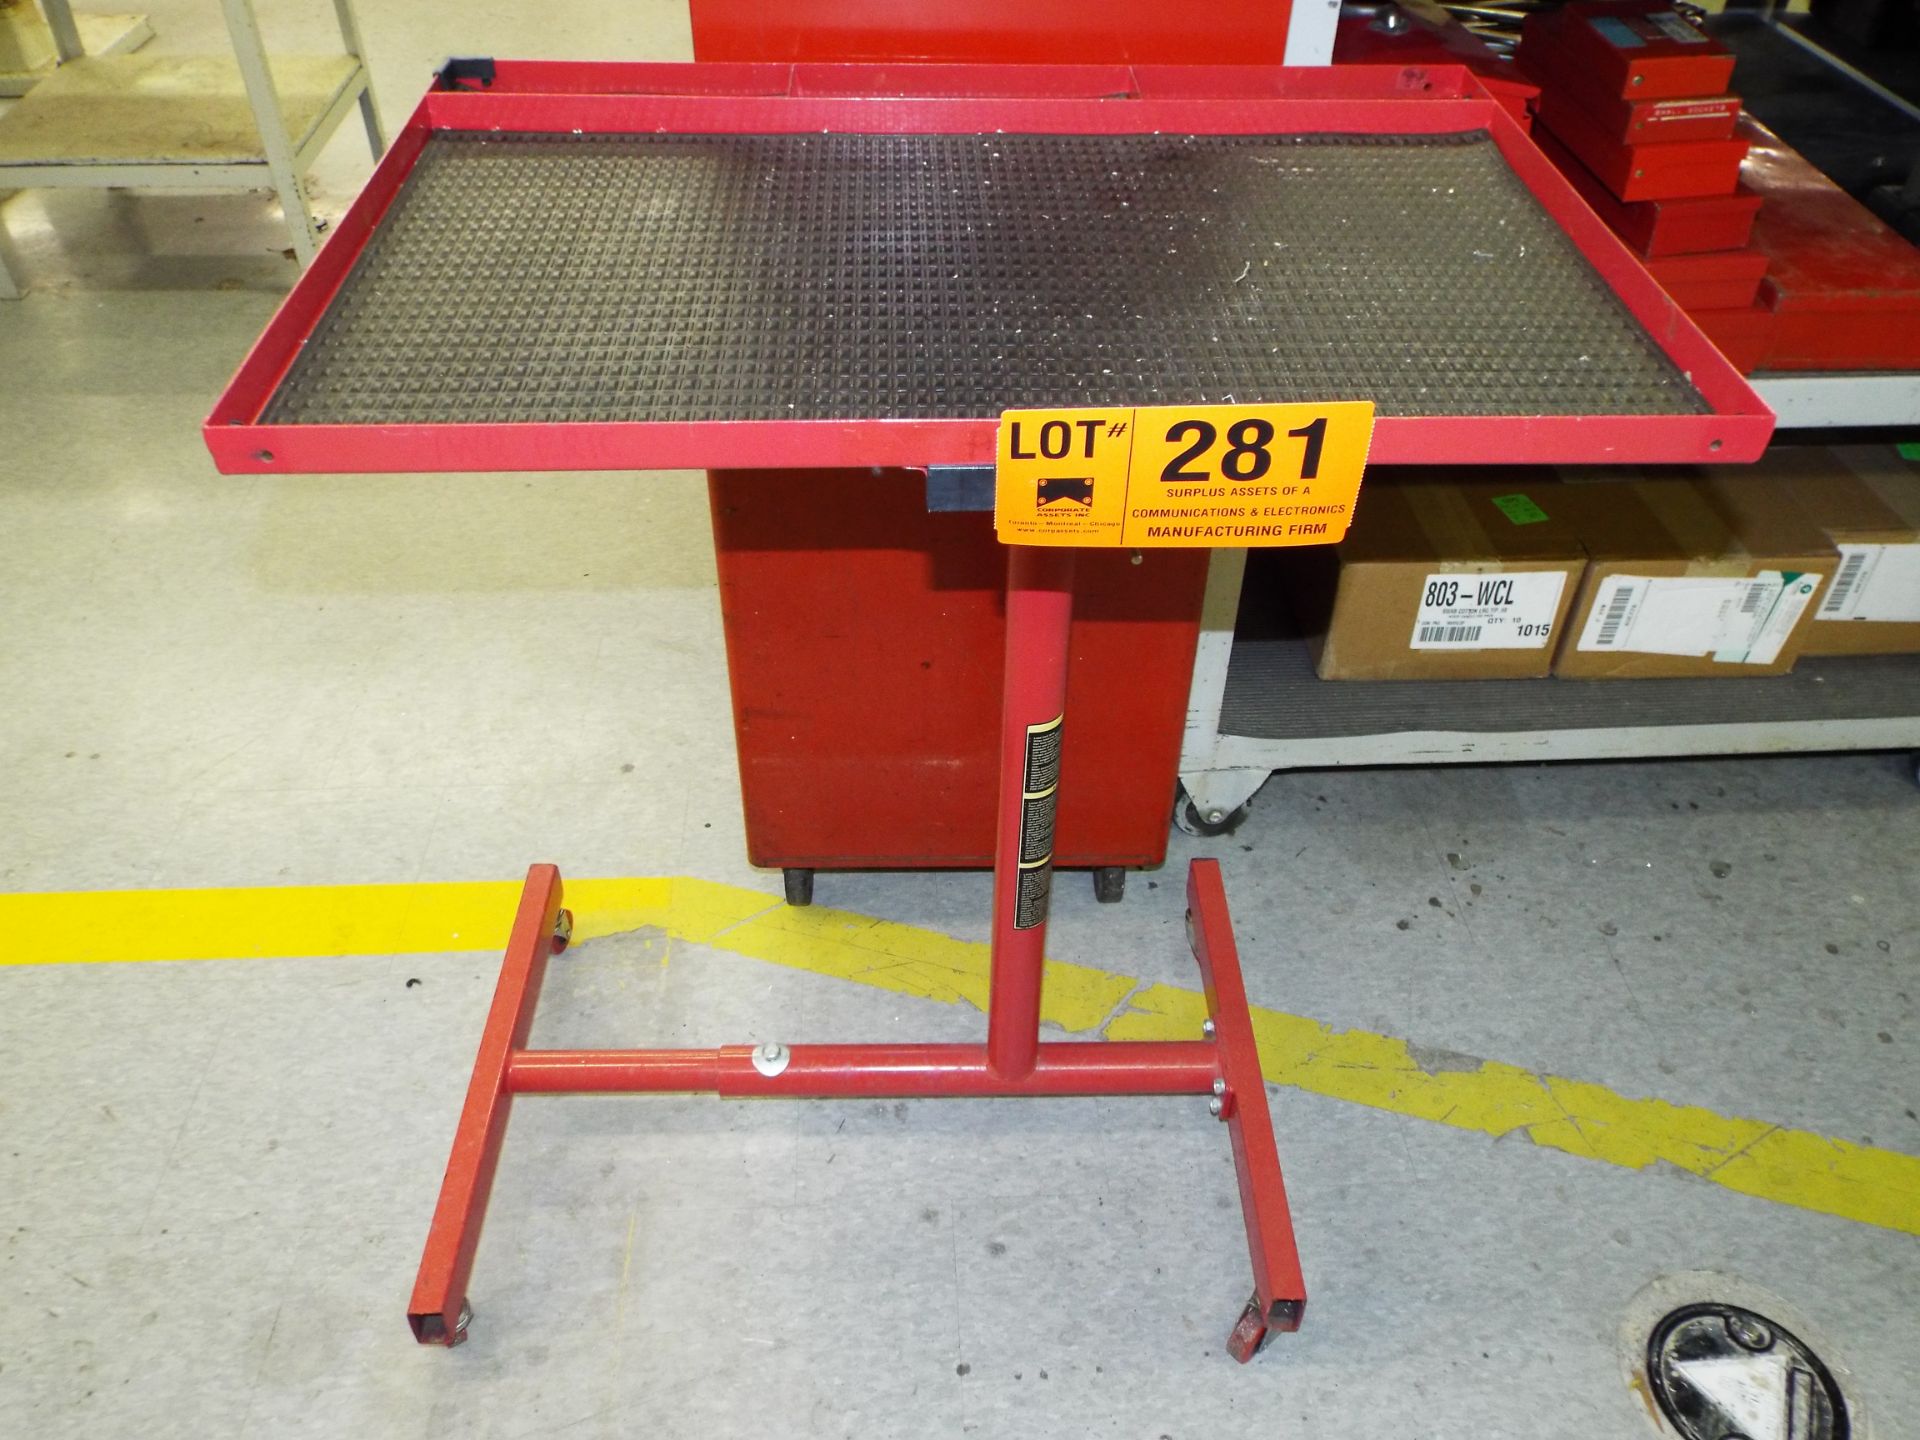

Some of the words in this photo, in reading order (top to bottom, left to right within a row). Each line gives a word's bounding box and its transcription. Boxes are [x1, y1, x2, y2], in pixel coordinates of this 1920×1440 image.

[1160, 417, 1328, 482] 281
[1167, 487, 1226, 497] SURPLUS
[1230, 486, 1278, 496] ASSETS
[1282, 486, 1298, 496] OF
[1303, 486, 1310, 495] A
[1132, 507, 1246, 518] COMMUNICATIONS
[1250, 507, 1258, 517] &
[1263, 504, 1346, 516] ELECTRONICS
[1147, 524, 1283, 538] MANUFACTURING
[1288, 523, 1328, 536] FIRM
[1517, 624, 1550, 637] 1015
